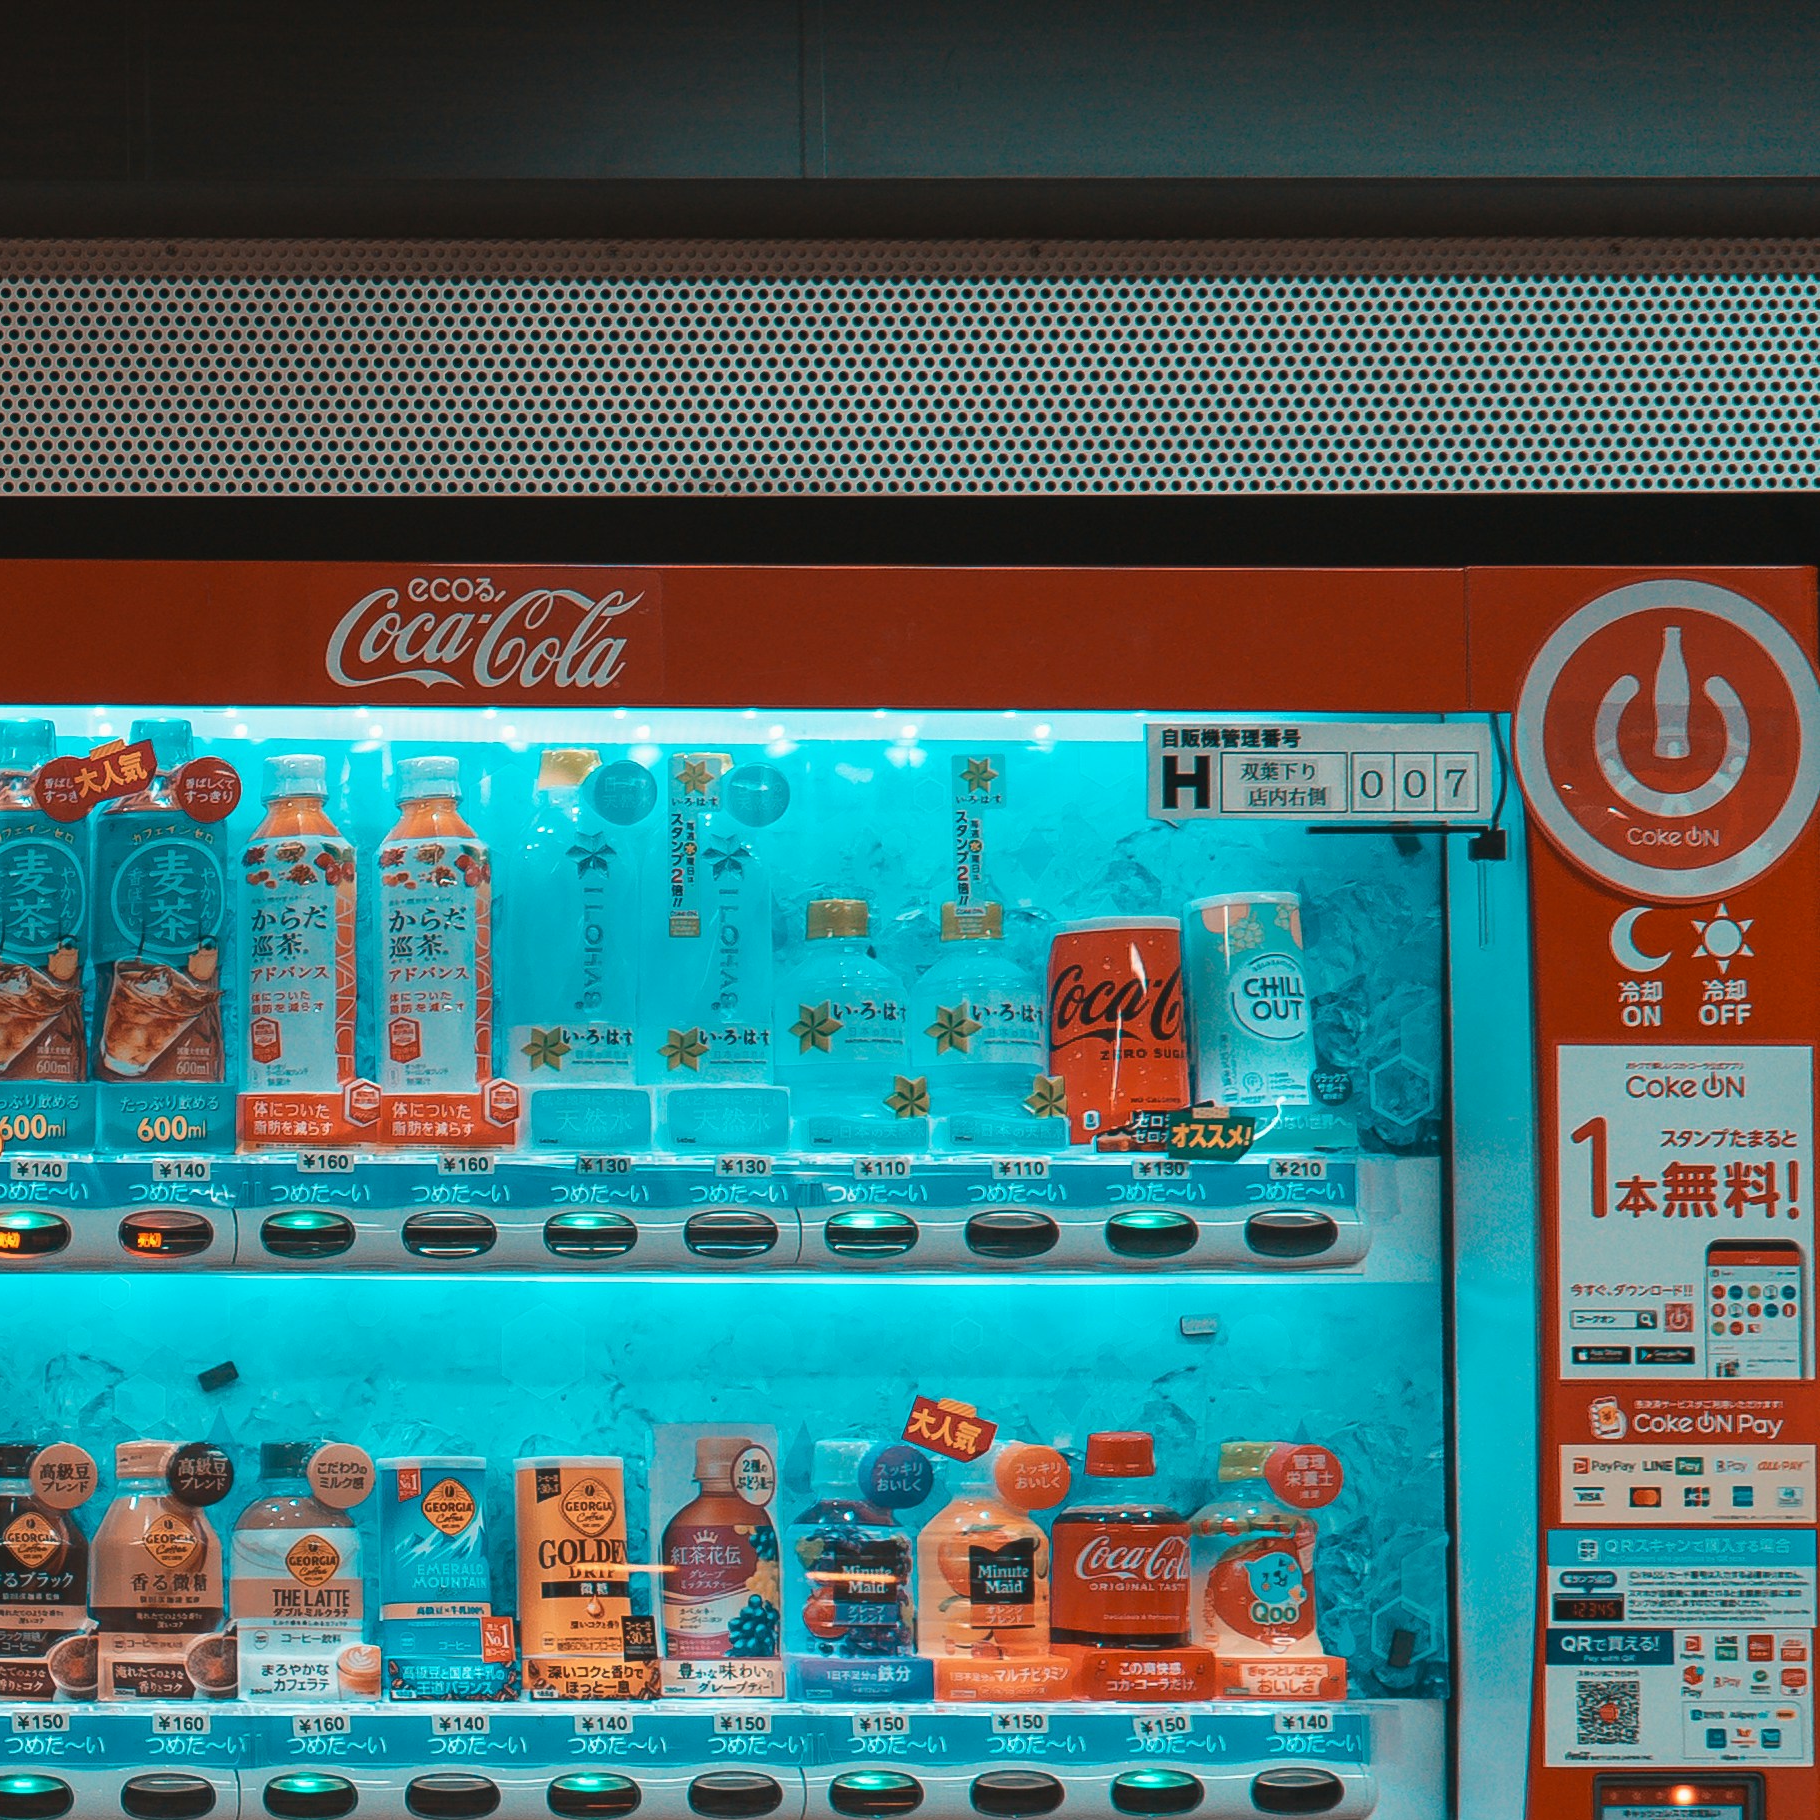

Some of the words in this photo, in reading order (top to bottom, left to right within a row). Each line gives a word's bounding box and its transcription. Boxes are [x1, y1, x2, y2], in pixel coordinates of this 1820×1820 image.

[325, 588, 645, 688] Coca-Cola
[1160, 728, 1301, 748] 自販機管理番号
[1161, 756, 1211, 809] H
[1241, 763, 1316, 781] 双葉下り
[1248, 787, 1328, 808] 店内右側
[1626, 826, 1680, 847] Coke
[1618, 981, 1663, 1003] 冷却
[1702, 979, 1747, 1002] 冷却
[1252, 999, 1302, 1021] OUT
[1622, 1006, 1661, 1028] ON
[1700, 1004, 1751, 1026] OFF
[253, 1100, 332, 1119] 体についた
[137, 1114, 207, 1141] 600ml
[254, 1119, 334, 1137] 脂肪を減らす
[1170, 1124, 1252, 1149] オススメ!
[17, 1162, 63, 1178] ¥140
[302, 1154, 349, 1170] ¥160
[1275, 1162, 1321, 1178] ¥210
[1571, 1116, 1800, 1219] 1本無料!
[909, 1406, 982, 1453] 大人気
